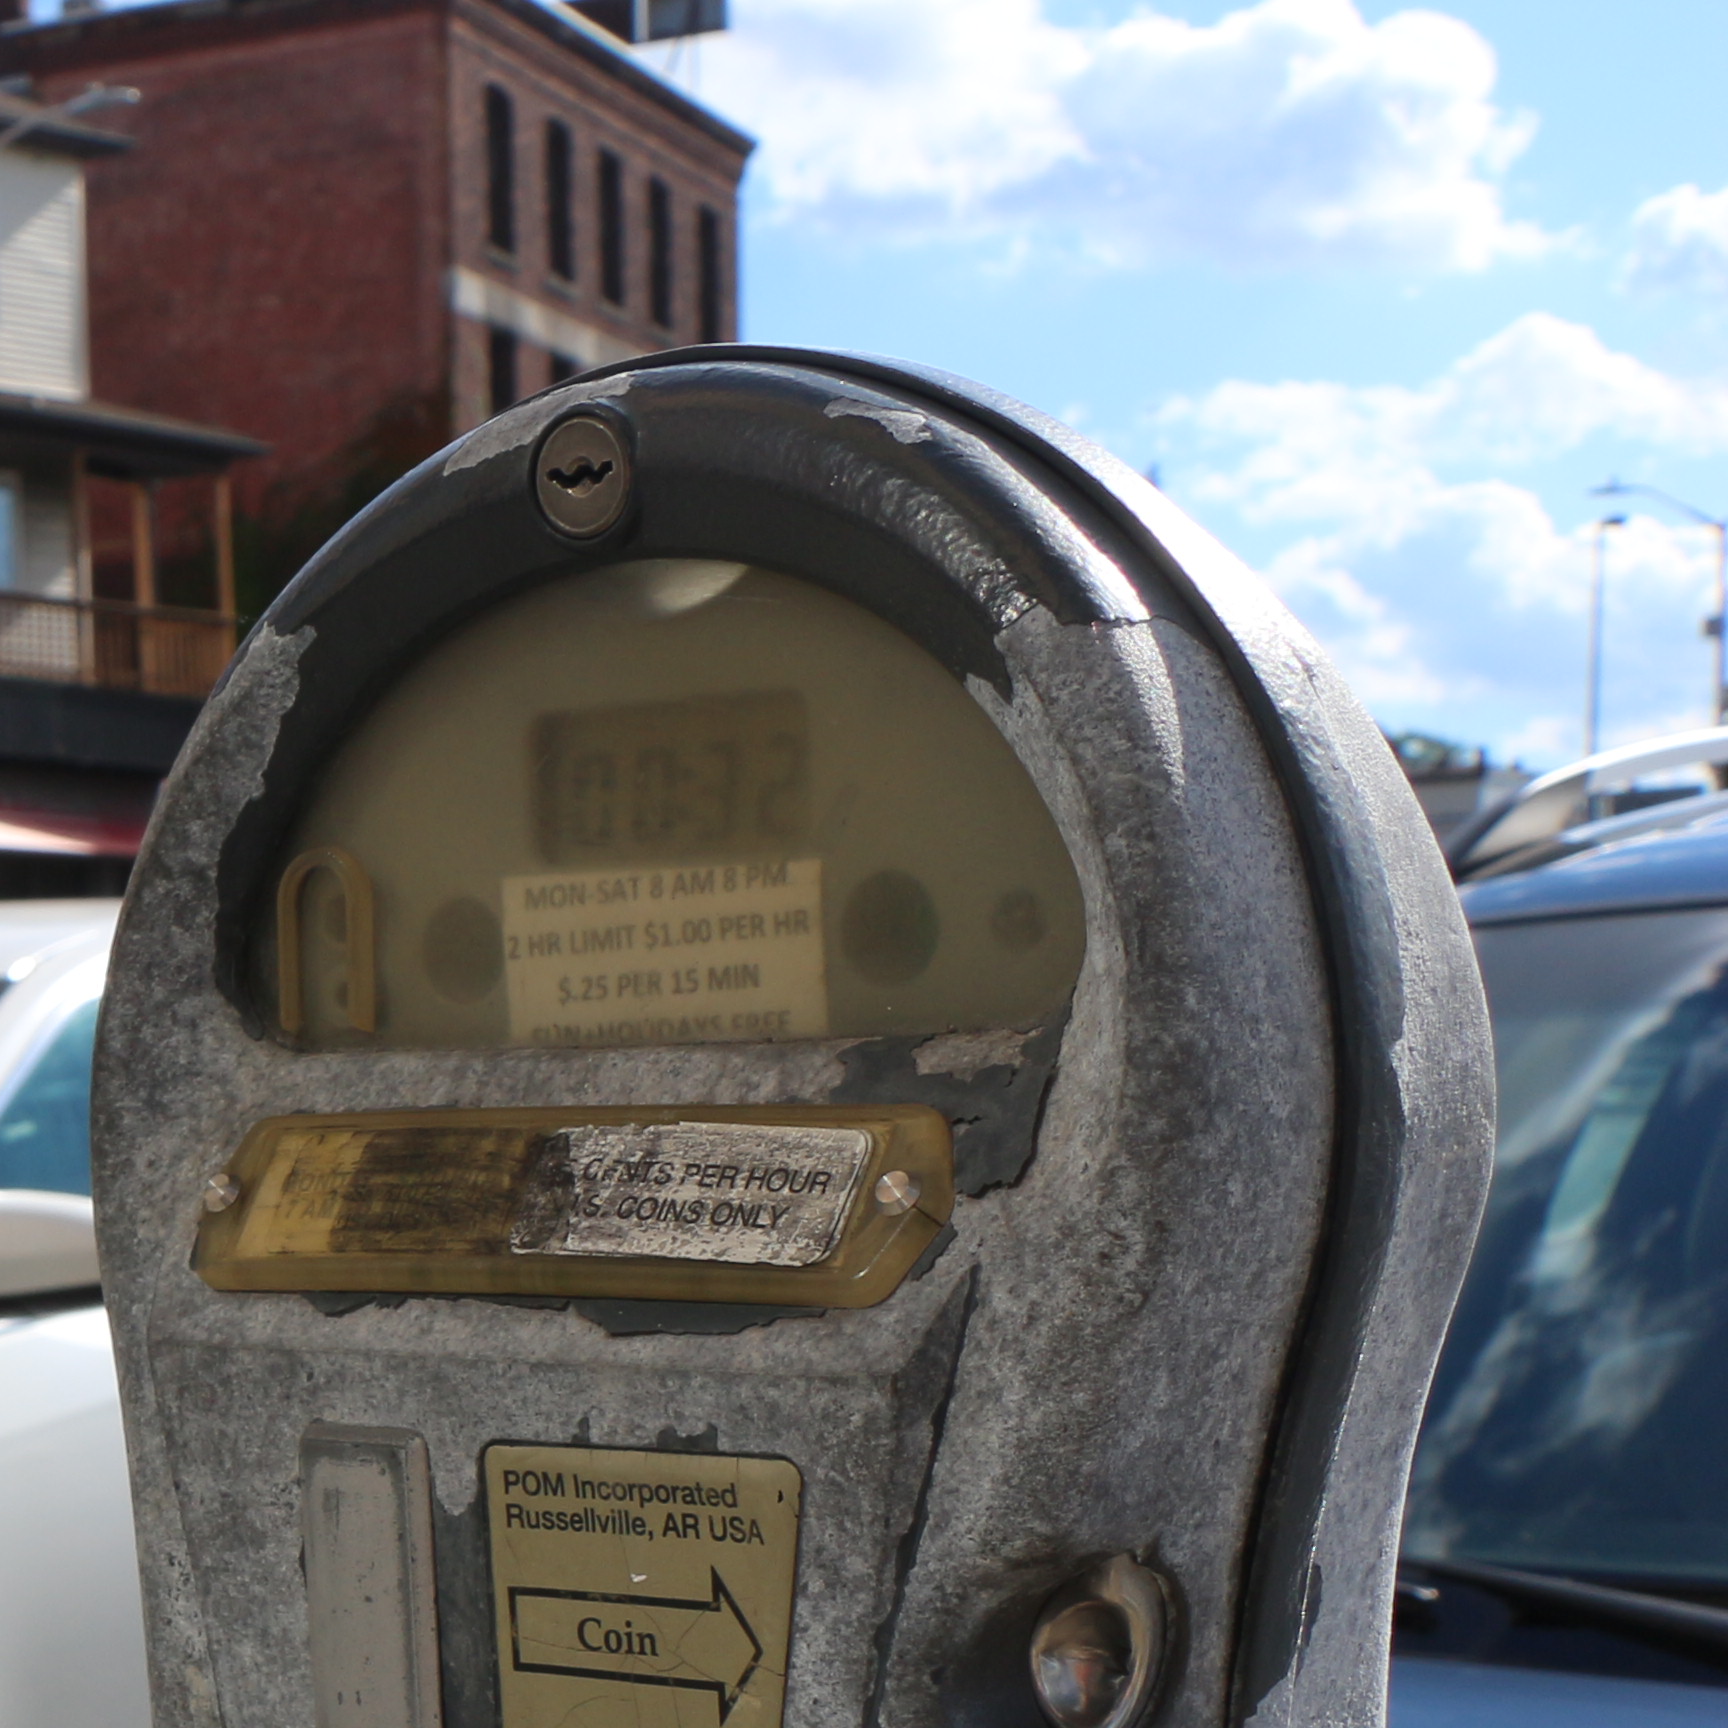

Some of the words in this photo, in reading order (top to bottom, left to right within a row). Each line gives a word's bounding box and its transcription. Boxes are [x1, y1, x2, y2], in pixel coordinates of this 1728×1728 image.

[524, 876, 642, 911] MON-SAT
[649, 873, 665, 900] 8
[671, 867, 716, 898] AM
[722, 865, 737, 893] 8
[745, 859, 790, 890] PM
[506, 935, 521, 960] 2
[528, 931, 562, 957] HR
[569, 923, 637, 955] LIMIT
[645, 915, 712, 951] $1.00
[718, 912, 766, 942] PER
[773, 908, 811, 937] HR
[557, 973, 609, 1006] $.25
[616, 968, 664, 999] PER
[671, 966, 700, 996] 15
[707, 961, 761, 993] MIN
[583, 1157, 674, 1187] CENTS
[679, 1162, 740, 1190] PER
[744, 1166, 832, 1196] HOUR
[615, 1195, 706, 1226] COINS
[709, 1200, 791, 1230] ONLY
[502, 1469, 565, 1499] POM
[573, 1472, 739, 1509] Incorporated
[505, 1502, 655, 1542] Russellville,
[661, 1511, 701, 1541] AR
[709, 1513, 765, 1547] USA
[576, 1615, 660, 1658] Coin
